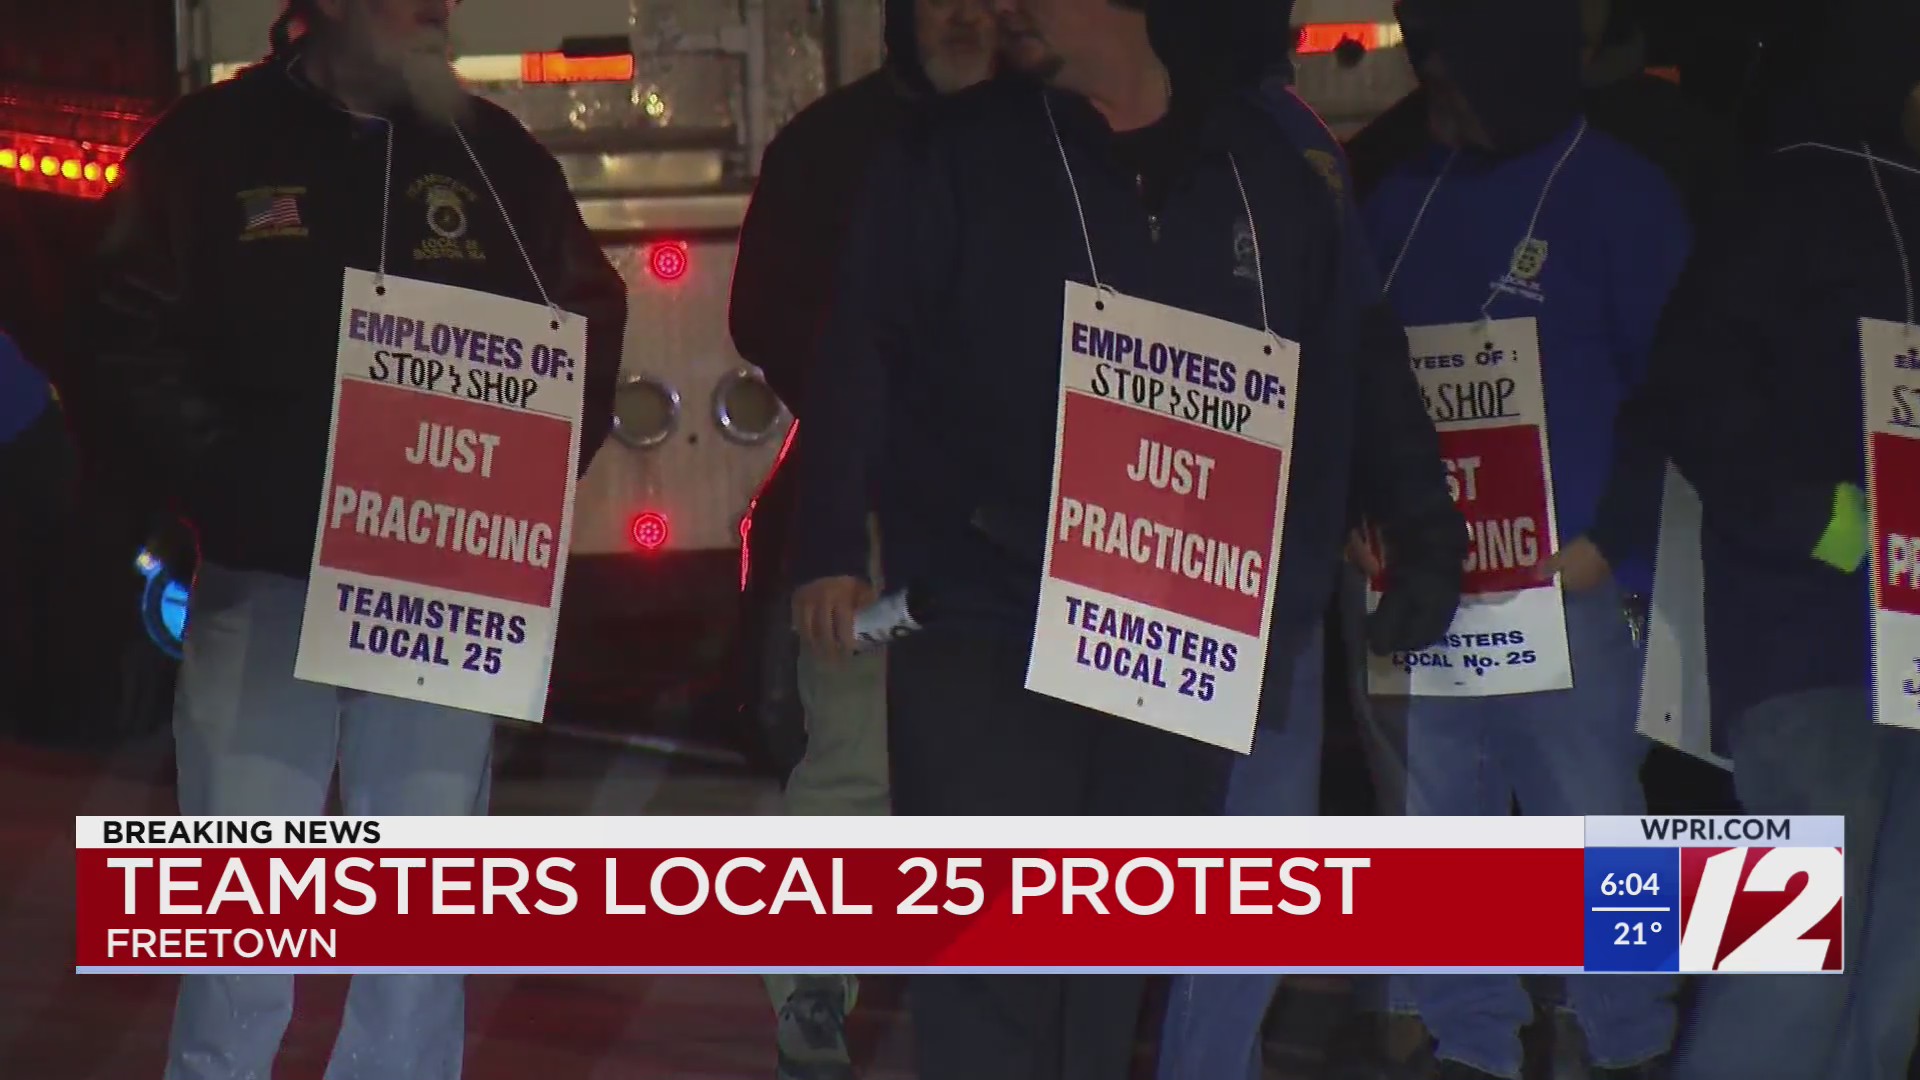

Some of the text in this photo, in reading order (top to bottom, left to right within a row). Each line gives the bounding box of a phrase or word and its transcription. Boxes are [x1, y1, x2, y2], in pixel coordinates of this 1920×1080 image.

[349, 308, 575, 381] EMPLOYEES OF:
[1071, 321, 1286, 409] EMPLOYEES OF:
[369, 350, 444, 390] STOP
[466, 369, 538, 408] SHOP
[1091, 362, 1164, 409] STOP
[1183, 390, 1252, 433] SHOP
[1434, 378, 1515, 421] SHOP
[405, 421, 500, 478] JUST
[1126, 438, 1216, 501] JUST
[331, 485, 553, 569] PRACTICING
[1059, 497, 1264, 598] PRACTICING
[336, 582, 527, 644] TEAMSTERS
[1064, 595, 1239, 673] TEAMSTERS
[349, 621, 503, 675] LOCAL 25
[1076, 636, 1216, 702] LOCAL 25
[1392, 652, 1453, 668] LOCAL
[1507, 650, 1537, 666] 25
